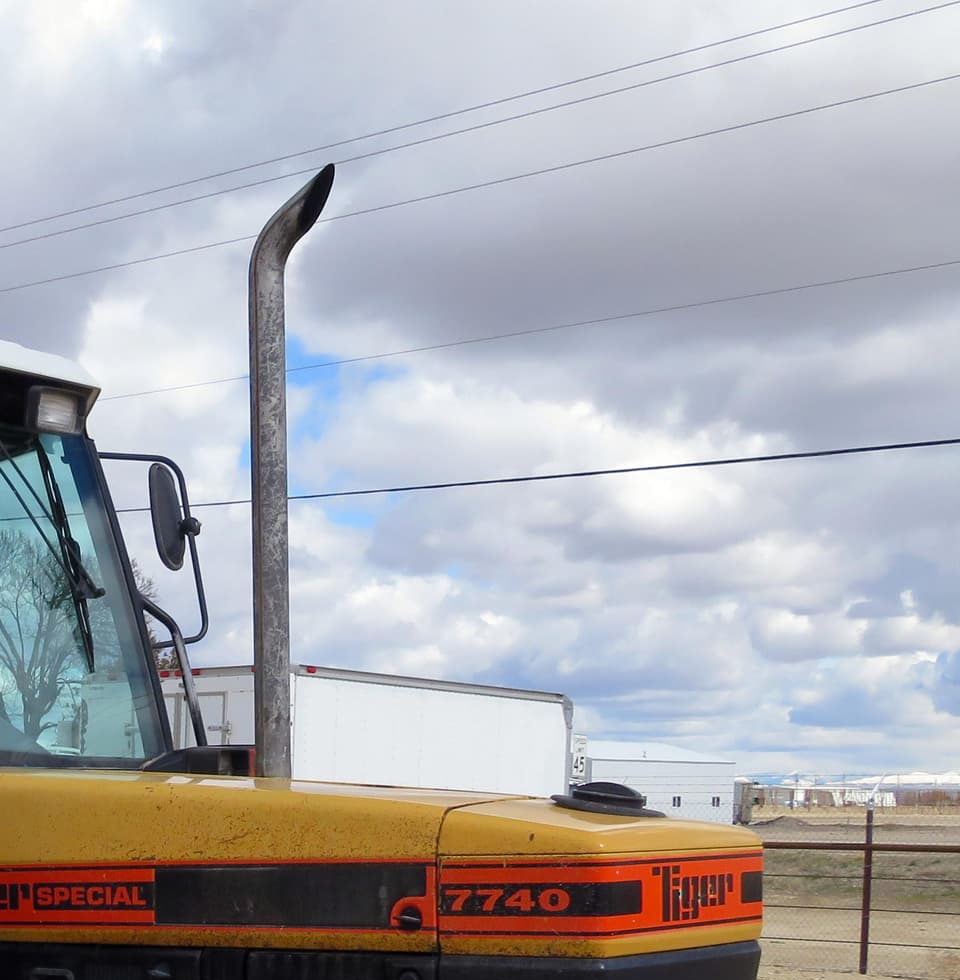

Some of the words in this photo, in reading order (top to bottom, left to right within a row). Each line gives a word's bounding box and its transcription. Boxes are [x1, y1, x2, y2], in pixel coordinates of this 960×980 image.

[573, 756, 585, 773] 45
[36, 886, 147, 906] SPECIAL
[444, 888, 571, 912] 7740
[652, 865, 734, 922] Tiger
